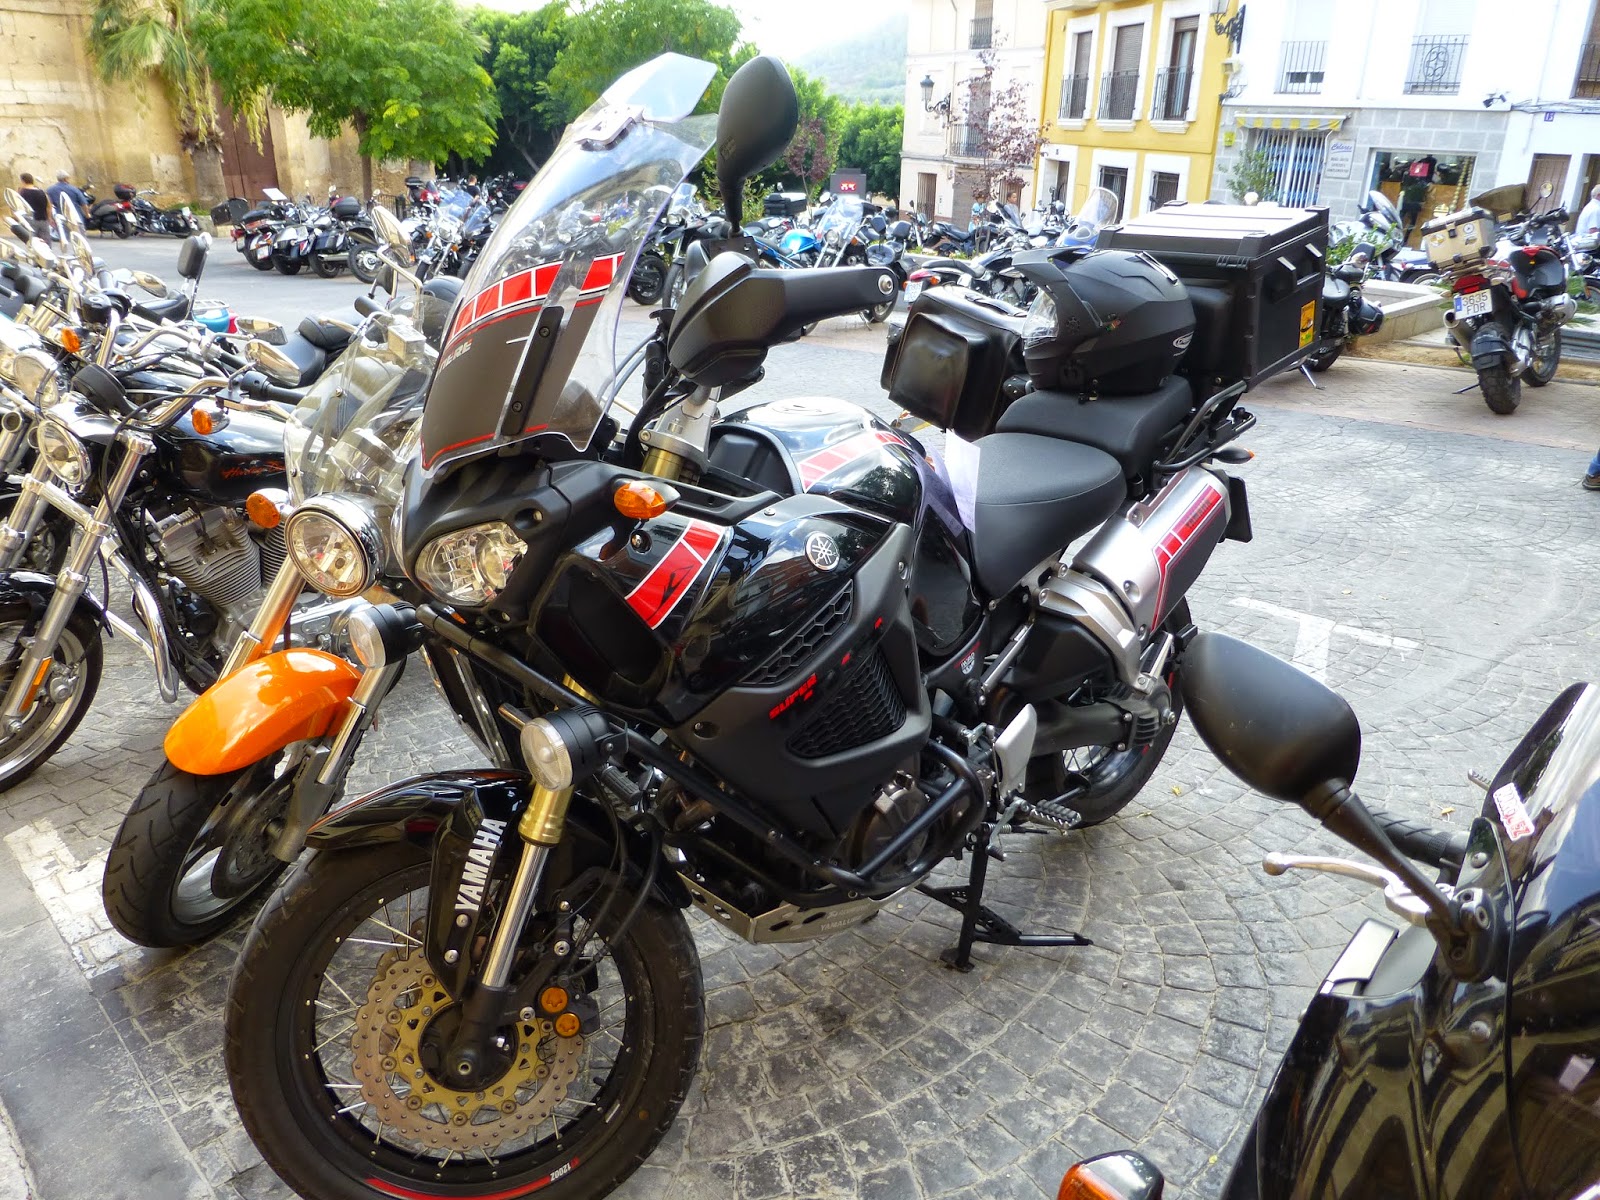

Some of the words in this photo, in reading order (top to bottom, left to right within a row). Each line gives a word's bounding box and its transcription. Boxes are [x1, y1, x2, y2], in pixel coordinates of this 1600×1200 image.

[1462, 291, 1488, 306] 3635
[1467, 302, 1486, 315] FDR
[769, 673, 817, 720] SUPER
[454, 818, 508, 911] YAMAHA
